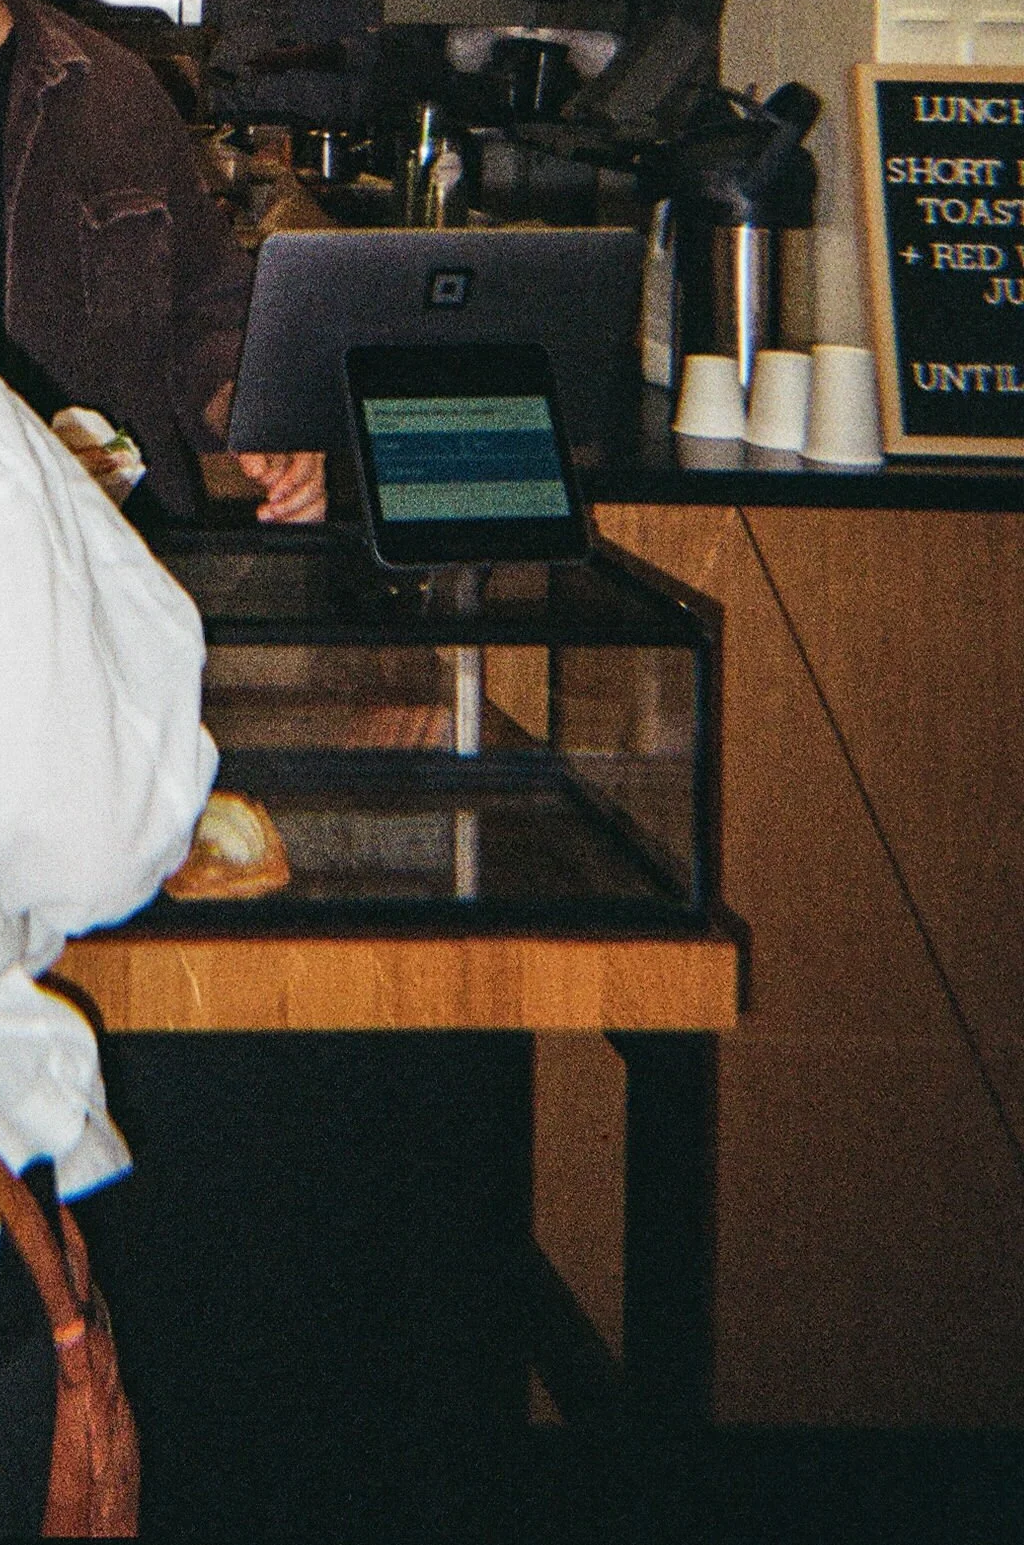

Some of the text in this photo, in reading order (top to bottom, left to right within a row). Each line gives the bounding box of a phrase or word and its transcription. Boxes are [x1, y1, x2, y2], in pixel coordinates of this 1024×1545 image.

[887, 157, 1002, 187] SHORT
[929, 243, 1005, 270] RED
[910, 362, 1024, 393] UNTIL
